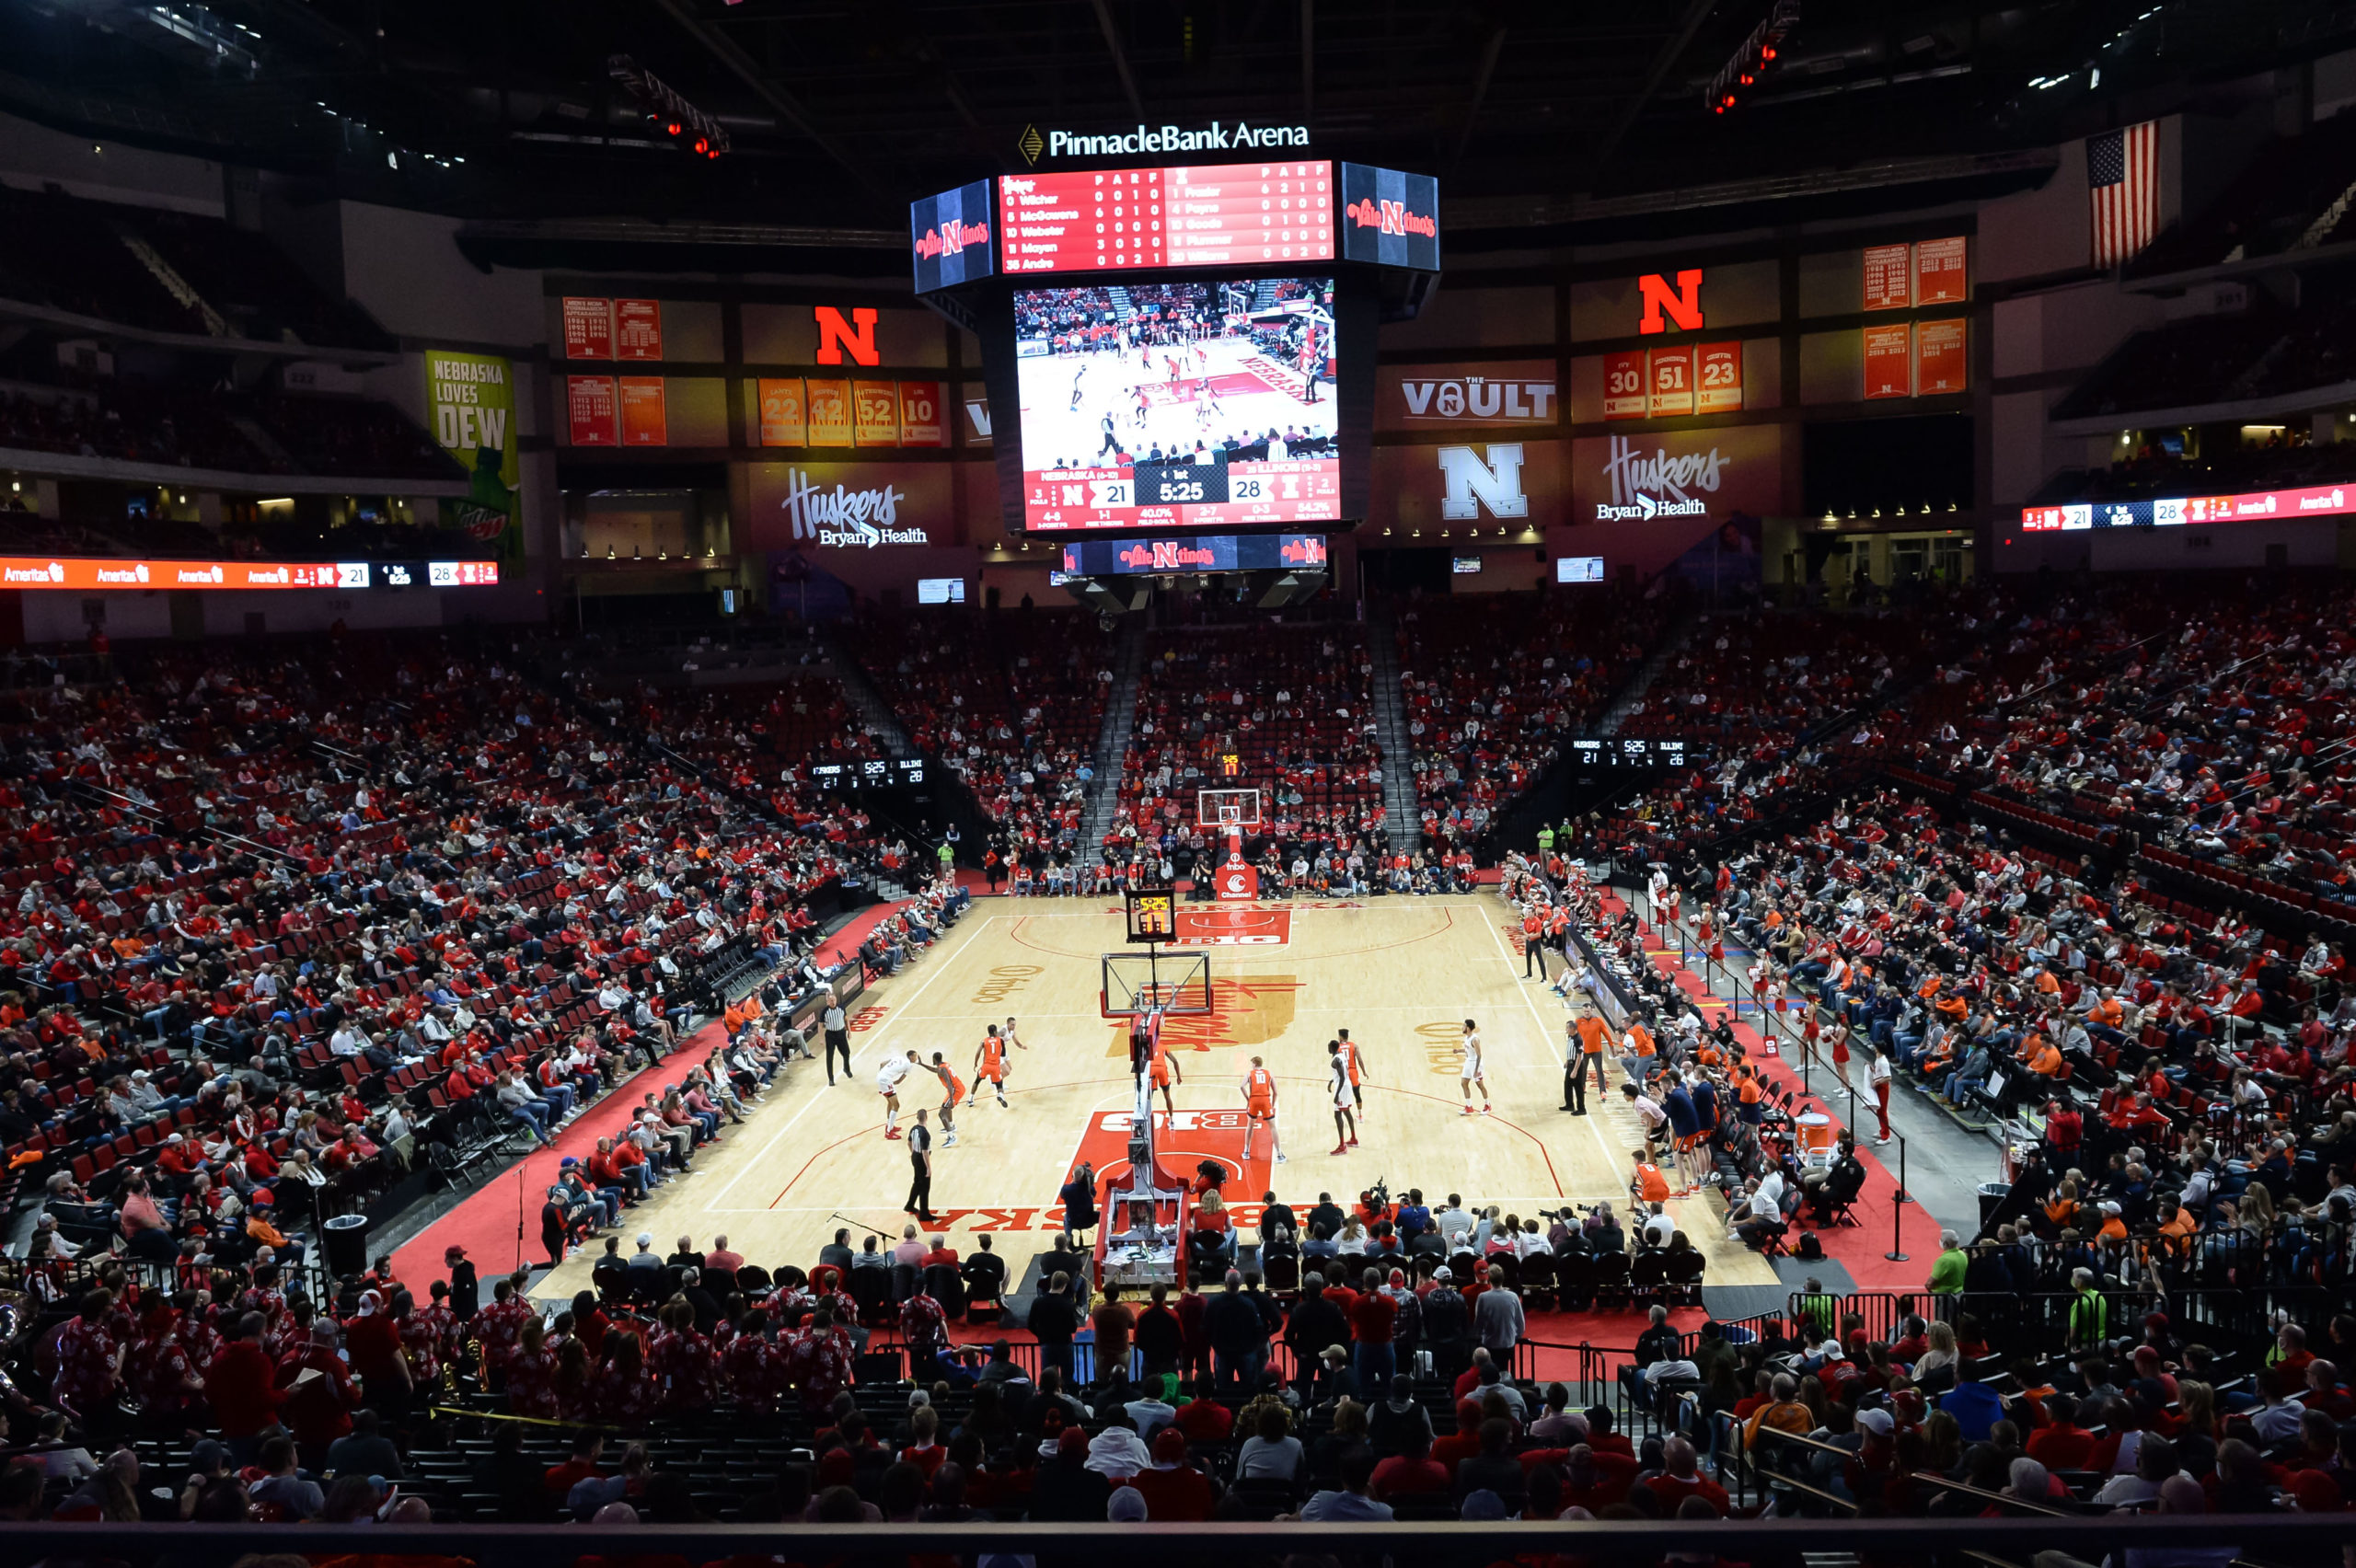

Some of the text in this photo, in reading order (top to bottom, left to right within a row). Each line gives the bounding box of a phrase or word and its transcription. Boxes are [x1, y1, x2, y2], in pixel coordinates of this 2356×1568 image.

[1232, 121, 1309, 148] Arena
[1095, 173, 1157, 186] P A R F
[1262, 165, 1323, 178] P A R F
[1133, 190, 1138, 200] 1
[1096, 208, 1103, 217] 6
[1134, 205, 1138, 215] 1
[1096, 224, 1104, 233] 0
[1115, 222, 1123, 232] 0
[1133, 222, 1141, 232] 0
[1151, 221, 1160, 231] 0
[1097, 239, 1104, 249] 3
[1115, 238, 1124, 248] 0
[1134, 237, 1141, 248] 3
[1152, 236, 1160, 247] 0
[1097, 255, 1105, 265] 0
[1116, 254, 1124, 264] 0
[1134, 254, 1141, 264] 2
[1154, 253, 1159, 263] 1
[1638, 269, 1704, 335] N
[814, 306, 880, 366] N
[434, 360, 503, 384] NEBRASKA
[1658, 366, 1684, 389] 51
[1704, 363, 1735, 386] 23
[1611, 371, 1639, 393] 30
[436, 383, 479, 404] LOVES
[765, 398, 798, 421] 22
[812, 399, 843, 421] 42
[860, 399, 891, 421] 52
[907, 400, 932, 421] 10
[1606, 402, 1616, 412] N
[1653, 398, 1662, 408] N
[437, 404, 506, 450] DEW
[1041, 471, 1095, 481] NEBRASKA
[1602, 436, 1730, 505] Huskers
[1236, 481, 1260, 498] 28
[1438, 444, 1528, 520] N
[1062, 485, 1084, 506] N
[1107, 486, 1126, 502] 21
[1160, 482, 1204, 502] 5:25
[781, 467, 905, 539] Huskers
[1597, 499, 1705, 522] Bryan Health
[2074, 511, 2085, 524] 21
[2159, 505, 2177, 519] 28
[819, 528, 927, 548] Bryan Health
[351, 570, 364, 582] 21
[434, 568, 450, 580] 28
[1574, 741, 1600, 749] HUSKERS
[1624, 741, 1645, 753] 5:25
[1584, 752, 1597, 763] 21
[865, 762, 884, 774] 5:25
[909, 770, 922, 782] 28
[1225, 764, 1237, 775] 17
[1141, 897, 1168, 911] 5:25
[1254, 1073, 1266, 1084] 10
